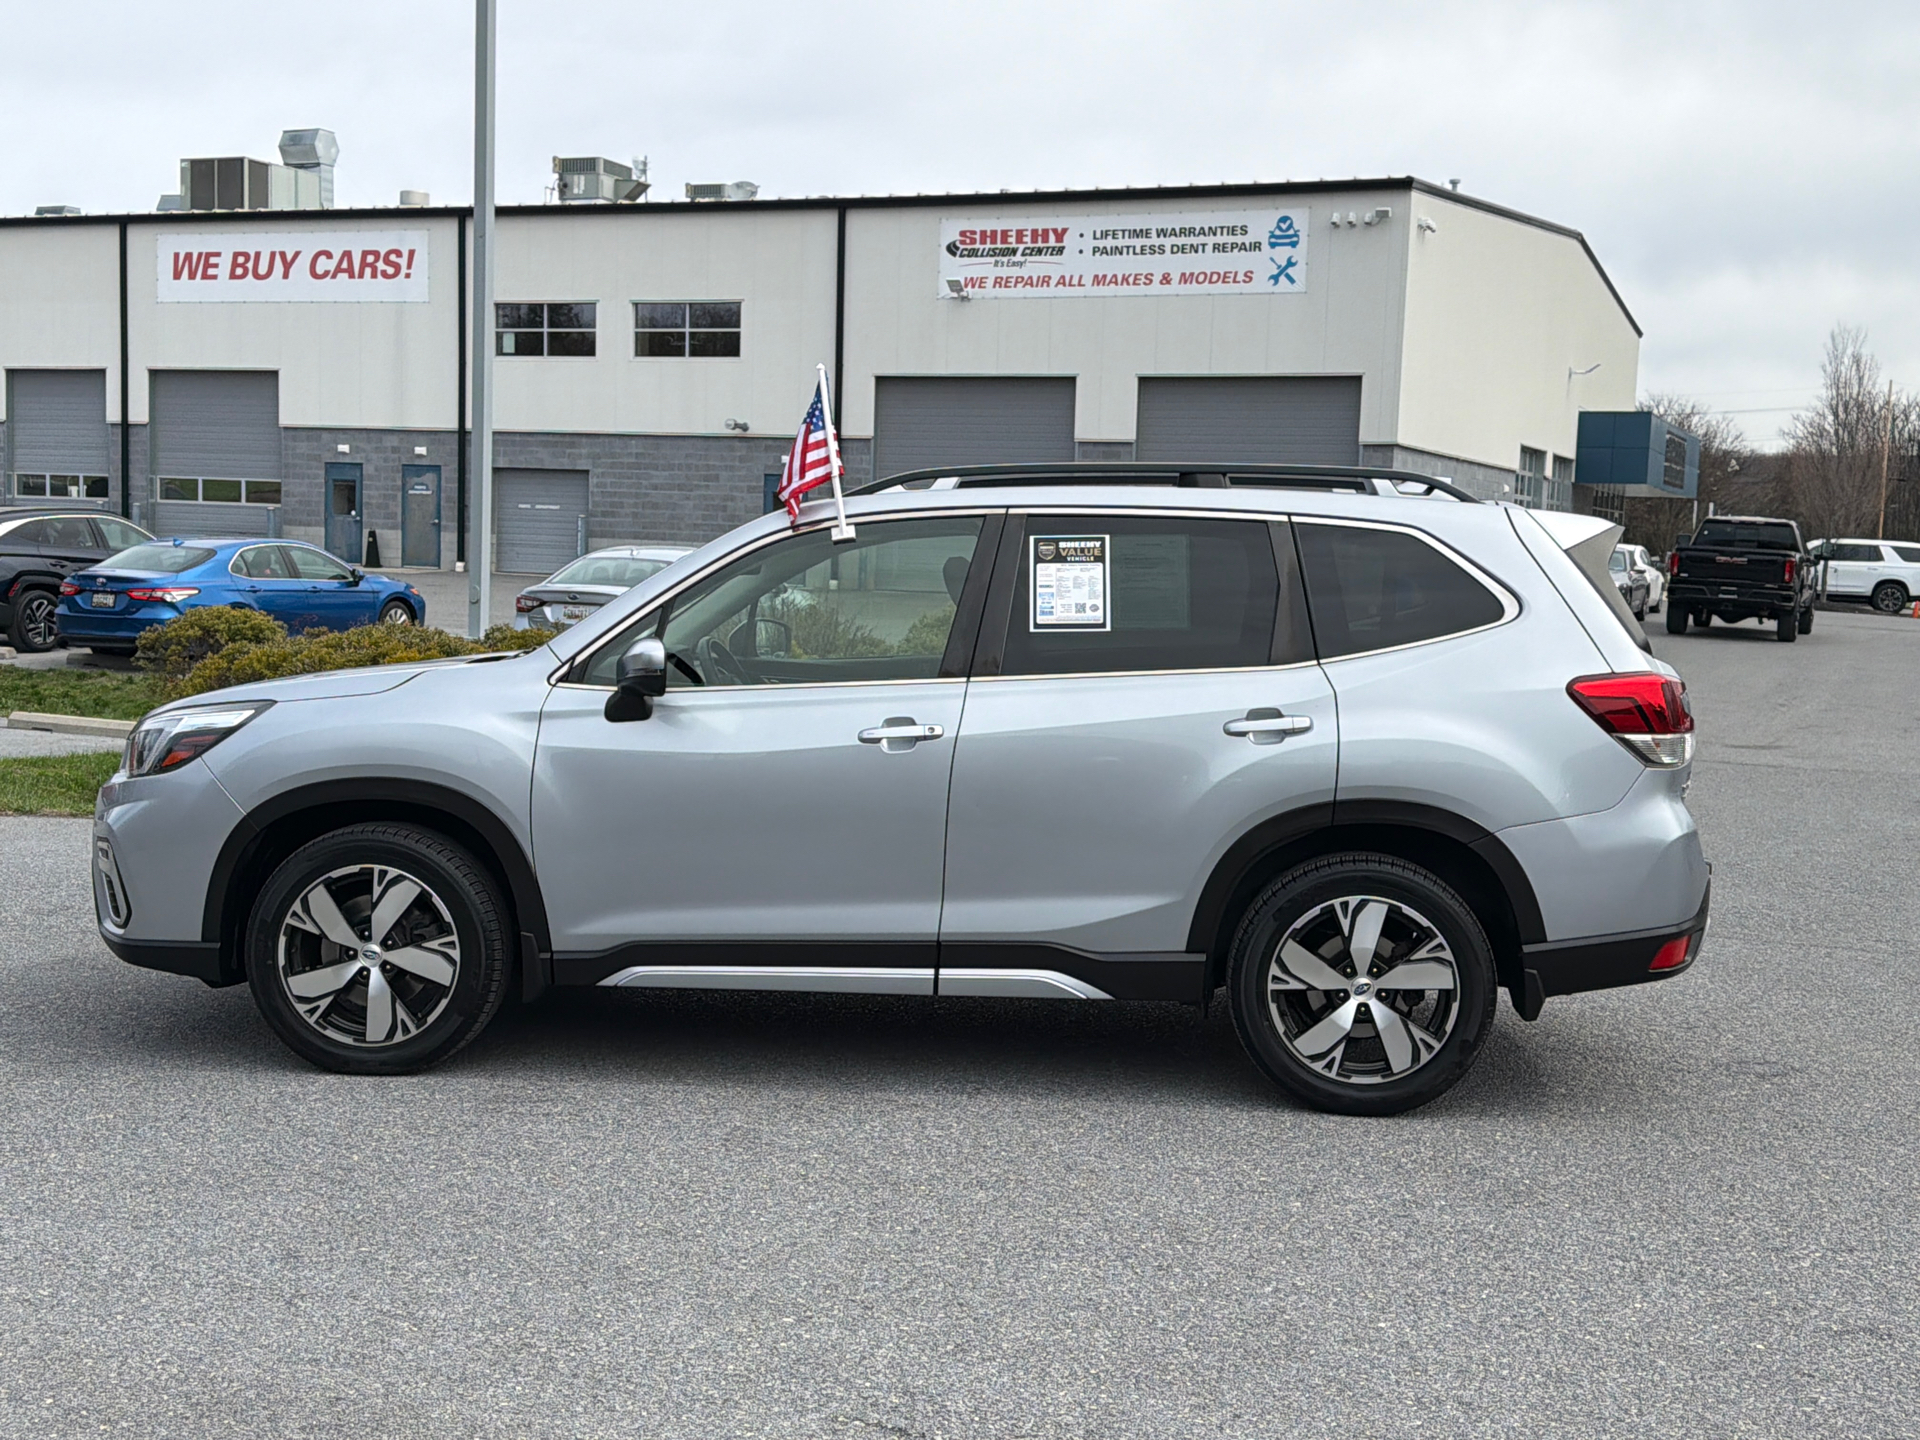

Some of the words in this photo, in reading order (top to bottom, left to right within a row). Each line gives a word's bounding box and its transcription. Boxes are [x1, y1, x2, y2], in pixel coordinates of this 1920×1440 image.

[958, 228, 1070, 246] SHEEHY
[1092, 228, 1152, 240] LIFETIME
[1156, 225, 1248, 238] WARRANTIES
[958, 246, 1016, 258] COLLISION
[1020, 246, 1066, 257] CENTER
[1092, 244, 1166, 256] PAINTLESS
[1170, 242, 1208, 255] DENT
[1212, 241, 1262, 254] REPAIR
[172, 251, 222, 280] WE
[228, 250, 302, 281] BUY
[308, 248, 416, 280] CARS!
[993, 259, 1004, 268] It's
[1006, 258, 1028, 269] Easy!
[963, 276, 988, 290] WE
[992, 274, 1052, 289] REPAIR
[1054, 274, 1086, 288] ALL
[1091, 272, 1154, 287] MAKES
[1158, 272, 1173, 286] &
[1178, 270, 1254, 286] MODELS
[1058, 540, 1102, 548] SHEEHY
[1059, 548, 1102, 556] VALUE
